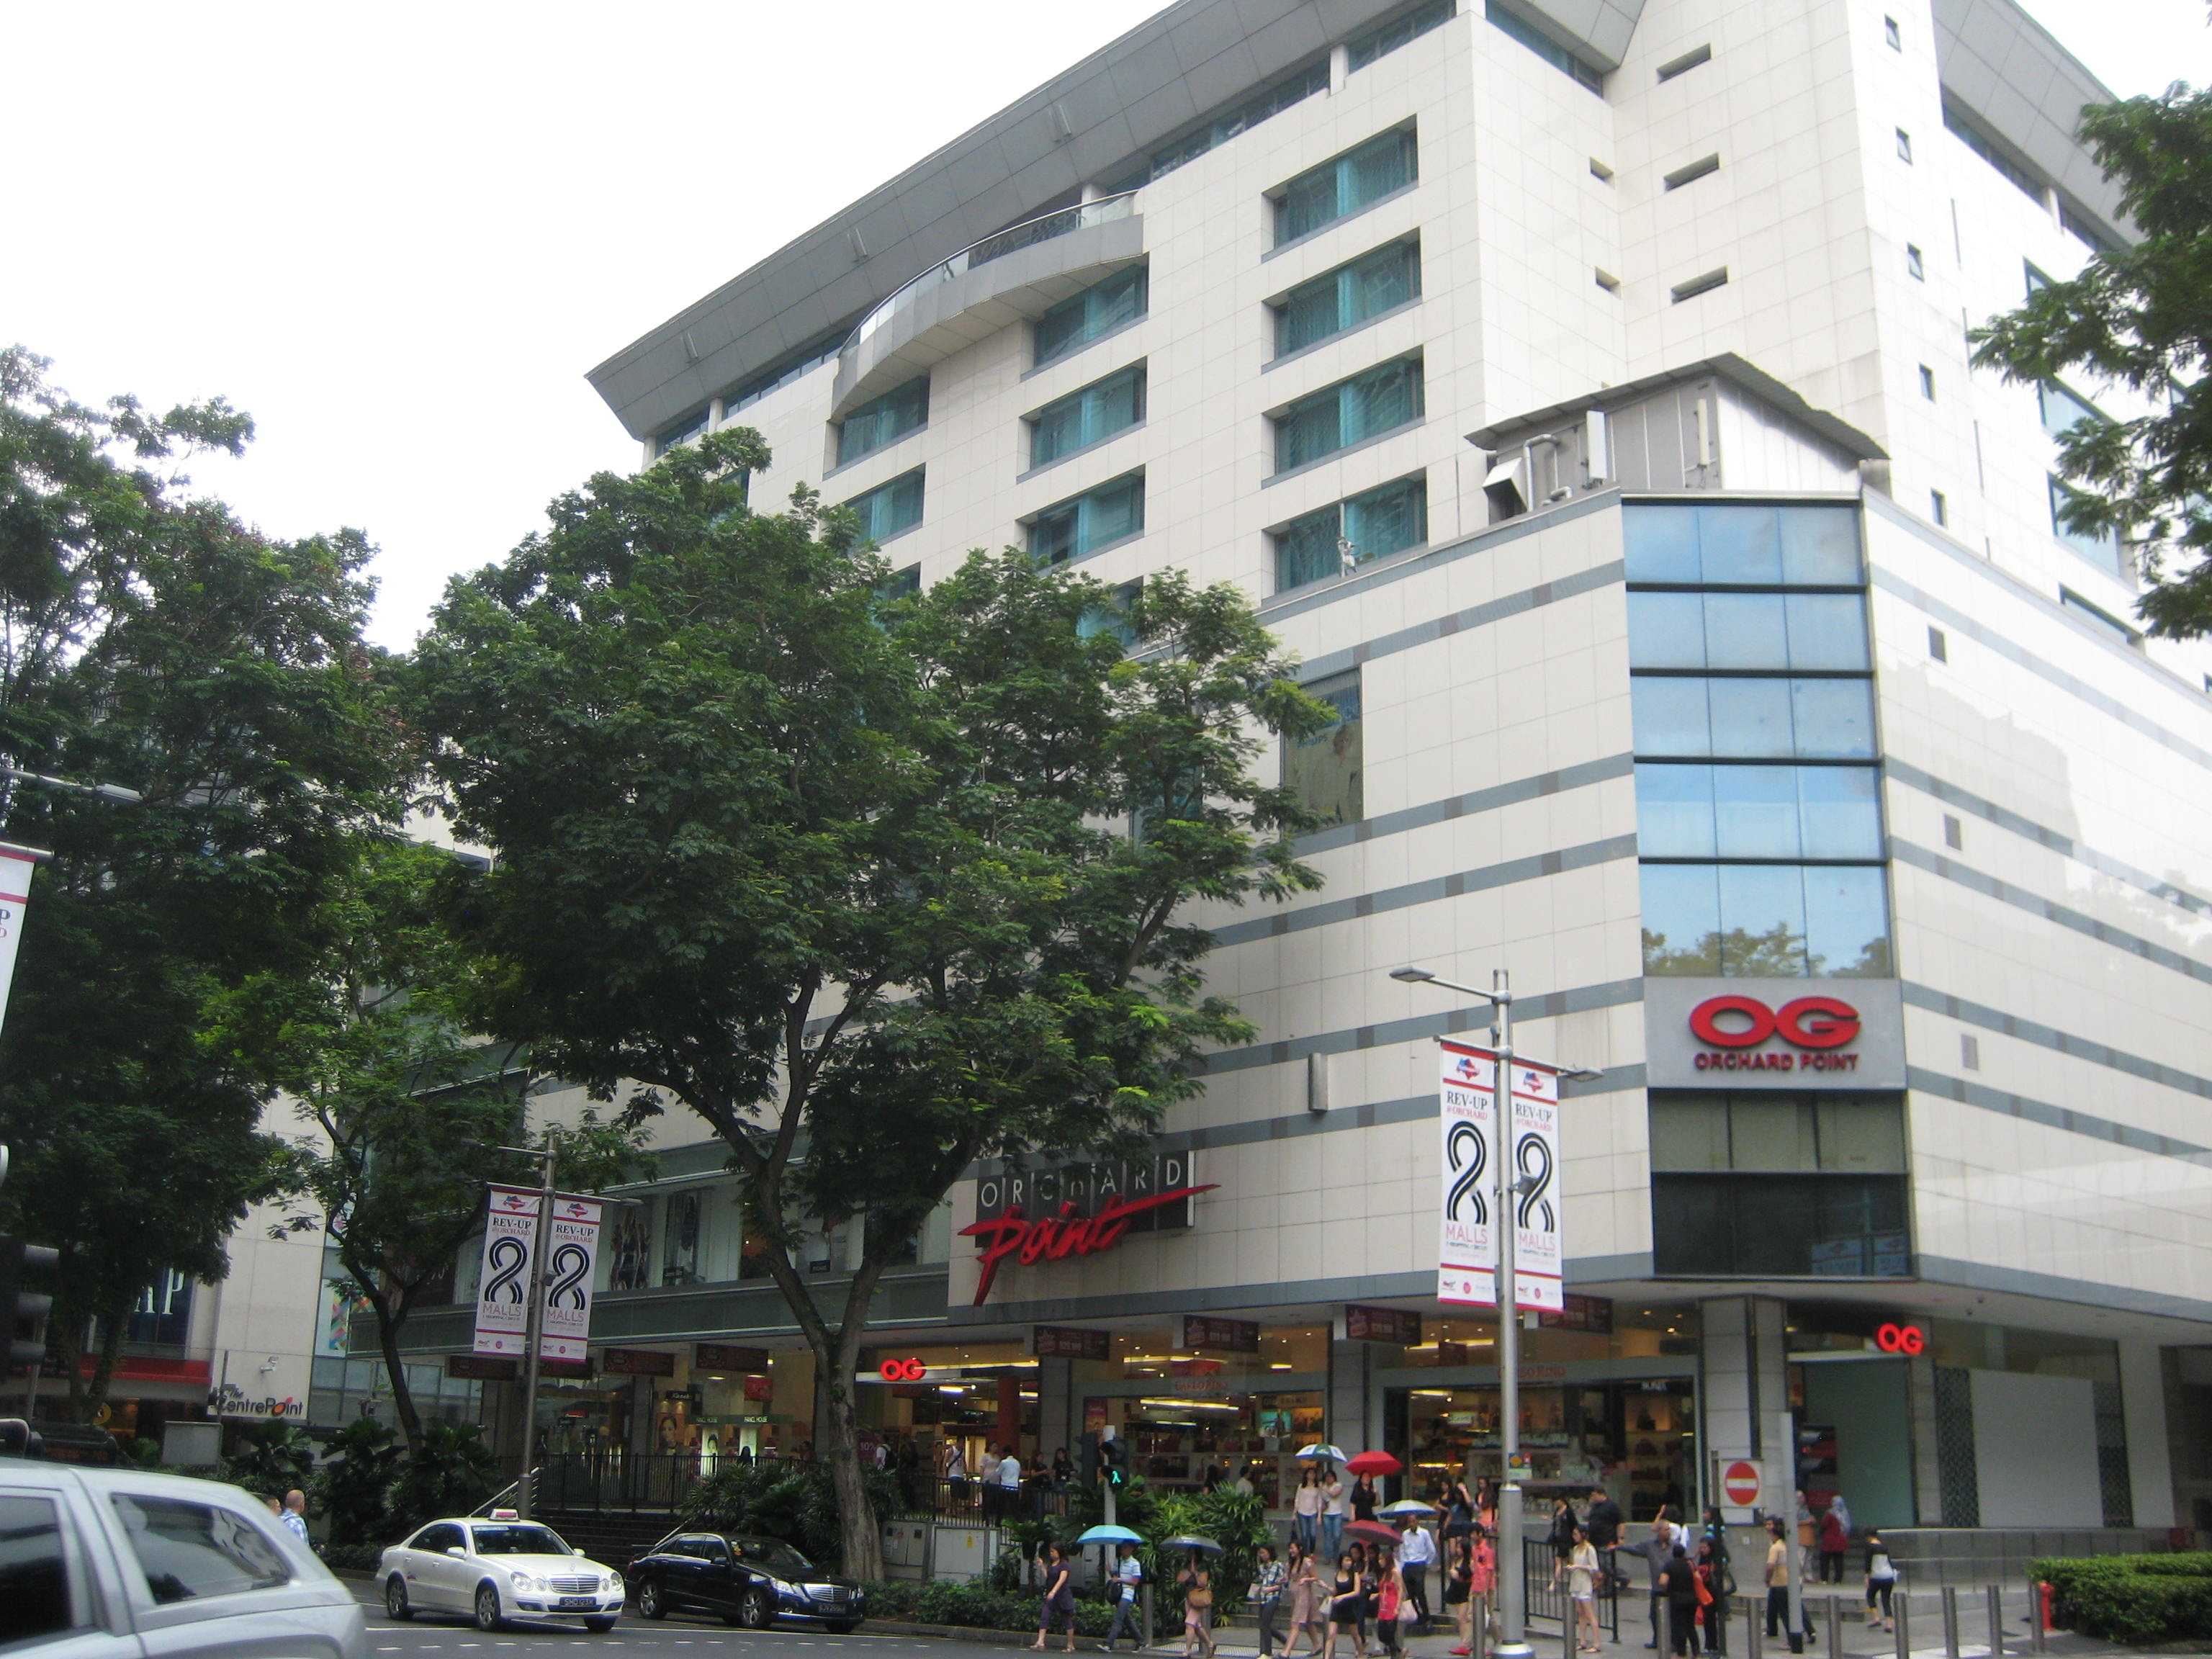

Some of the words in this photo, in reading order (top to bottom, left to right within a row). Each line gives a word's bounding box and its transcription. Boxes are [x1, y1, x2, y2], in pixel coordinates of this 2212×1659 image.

[1689, 994, 1861, 1048] OG
[1694, 1053, 1794, 1071] ORCHARD
[1800, 1053, 1859, 1071] POINT
[1447, 1090, 1488, 1110] REV-UP
[1515, 1102, 1552, 1122] REV-UP
[493, 1217, 531, 1228] REV-UP
[555, 1224, 594, 1236] REV-UP
[1446, 1223, 1488, 1244] MALLS
[1519, 1231, 1556, 1252] MALLS
[482, 1303, 522, 1317] MALLS
[547, 1308, 585, 1323] MALLS
[1876, 1322, 1925, 1355] OG
[880, 1358, 926, 1381] OG
